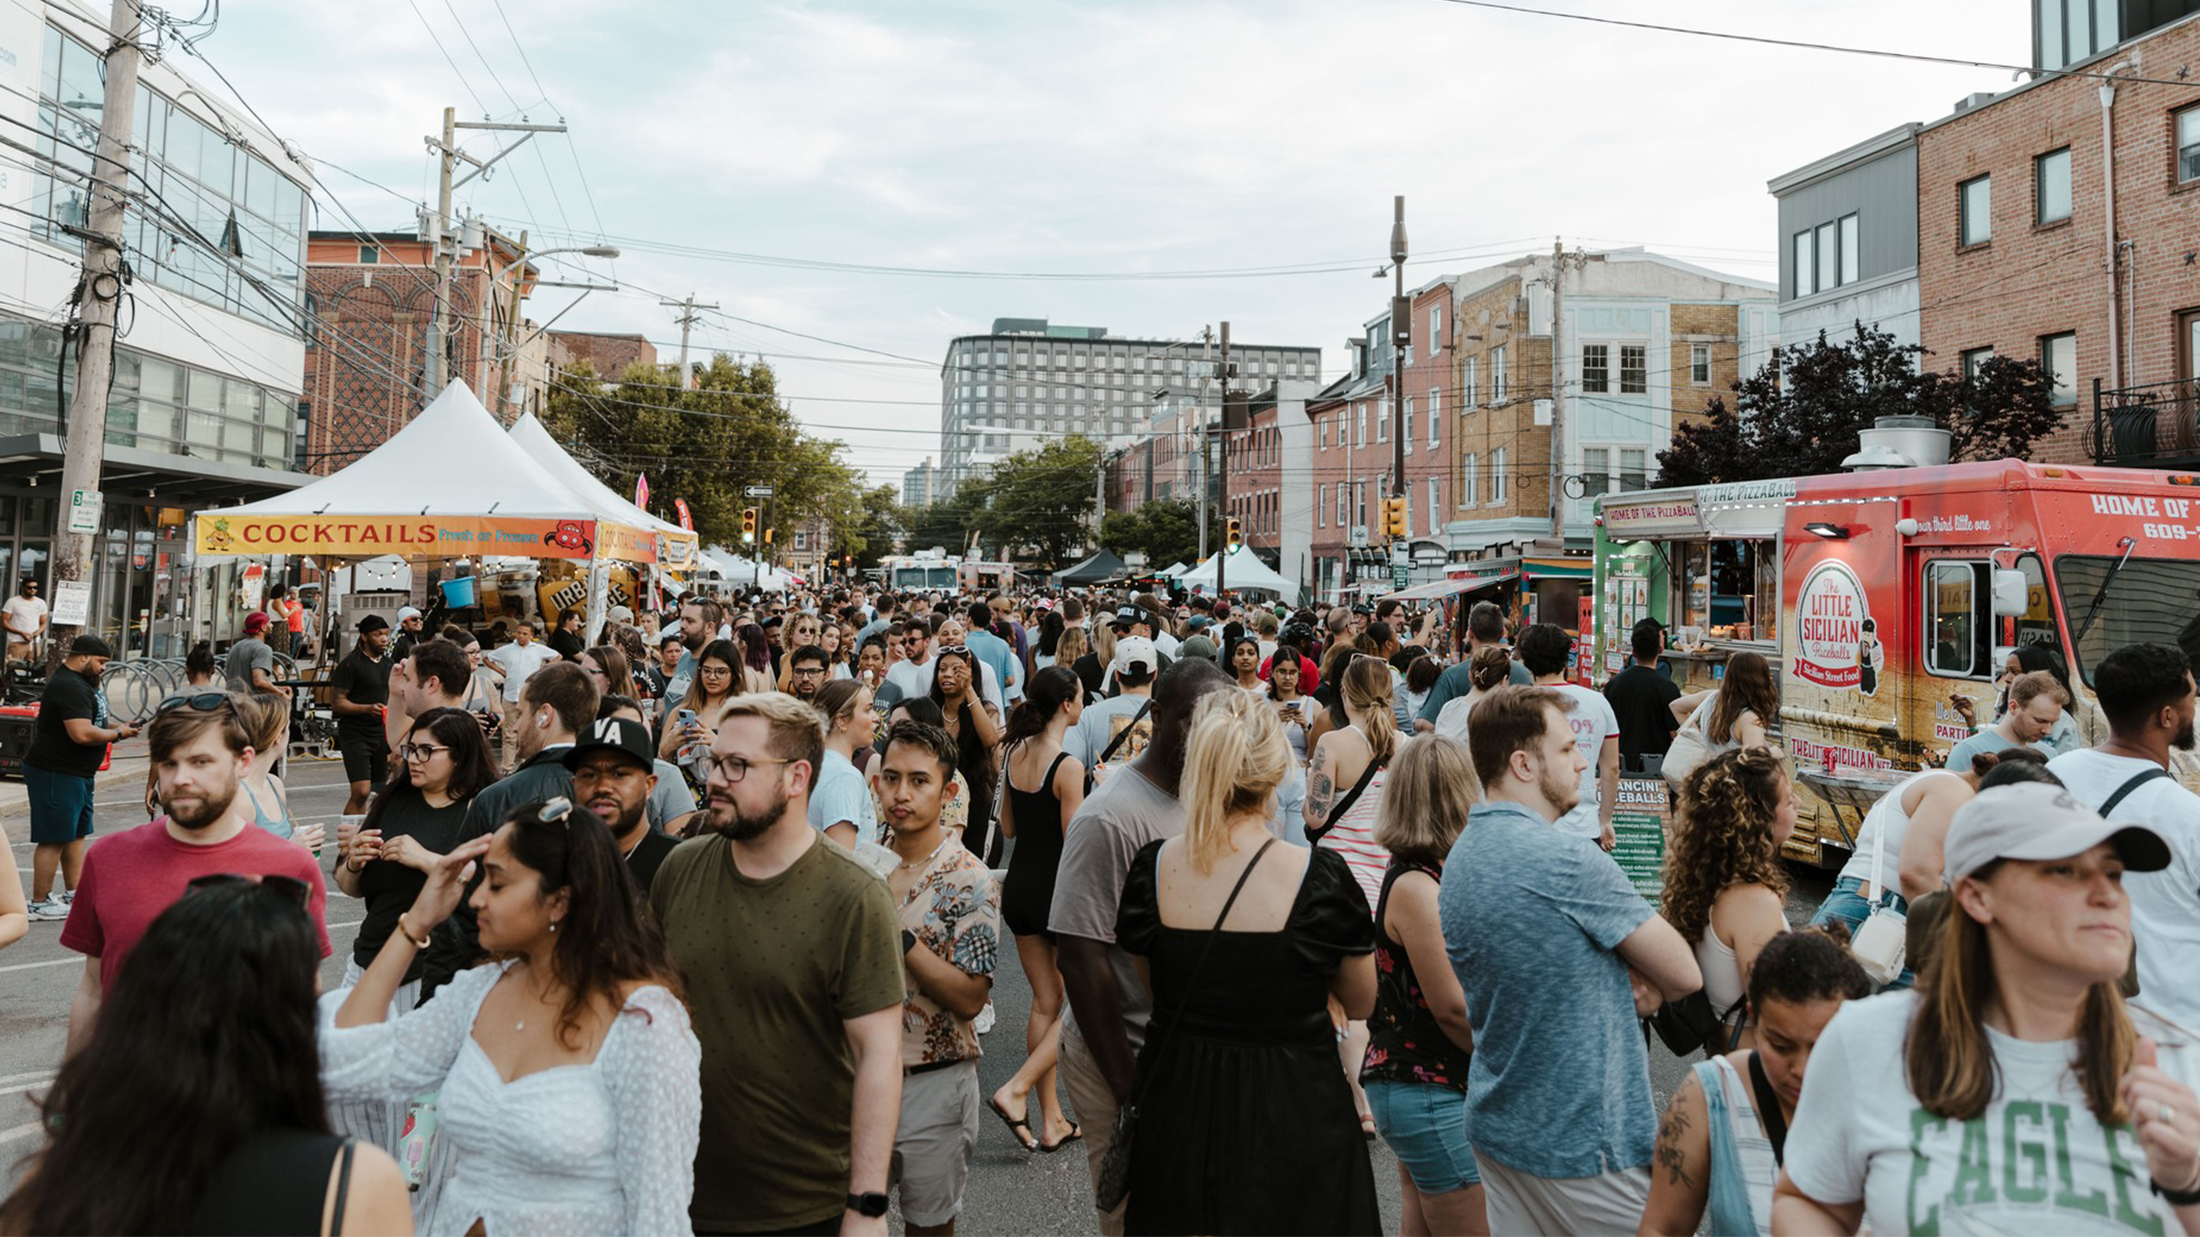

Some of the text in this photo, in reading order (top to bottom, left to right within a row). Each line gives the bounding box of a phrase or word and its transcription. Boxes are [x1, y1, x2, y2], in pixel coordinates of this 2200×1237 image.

[1713, 486, 1733, 502] THE
[1610, 510, 1631, 521] HOME
[1631, 509, 1640, 519] OF
[1642, 508, 1656, 519] THE
[2090, 494, 2190, 518] HOME OF
[1933, 515, 1953, 532] third
[1954, 514, 1974, 531] little
[1974, 520, 1991, 531] one
[243, 524, 538, 544] COCKTAILS Fresh or Frozen
[1823, 579, 1840, 594] The
[1811, 594, 1852, 617] LITTLE
[1803, 618, 1859, 644] SICILIAN
[1811, 641, 1851, 660] Riceballs
[1803, 663, 1860, 682] Sicilian Street Food
[875, 696, 890, 708] ime
[594, 717, 622, 745] VA
